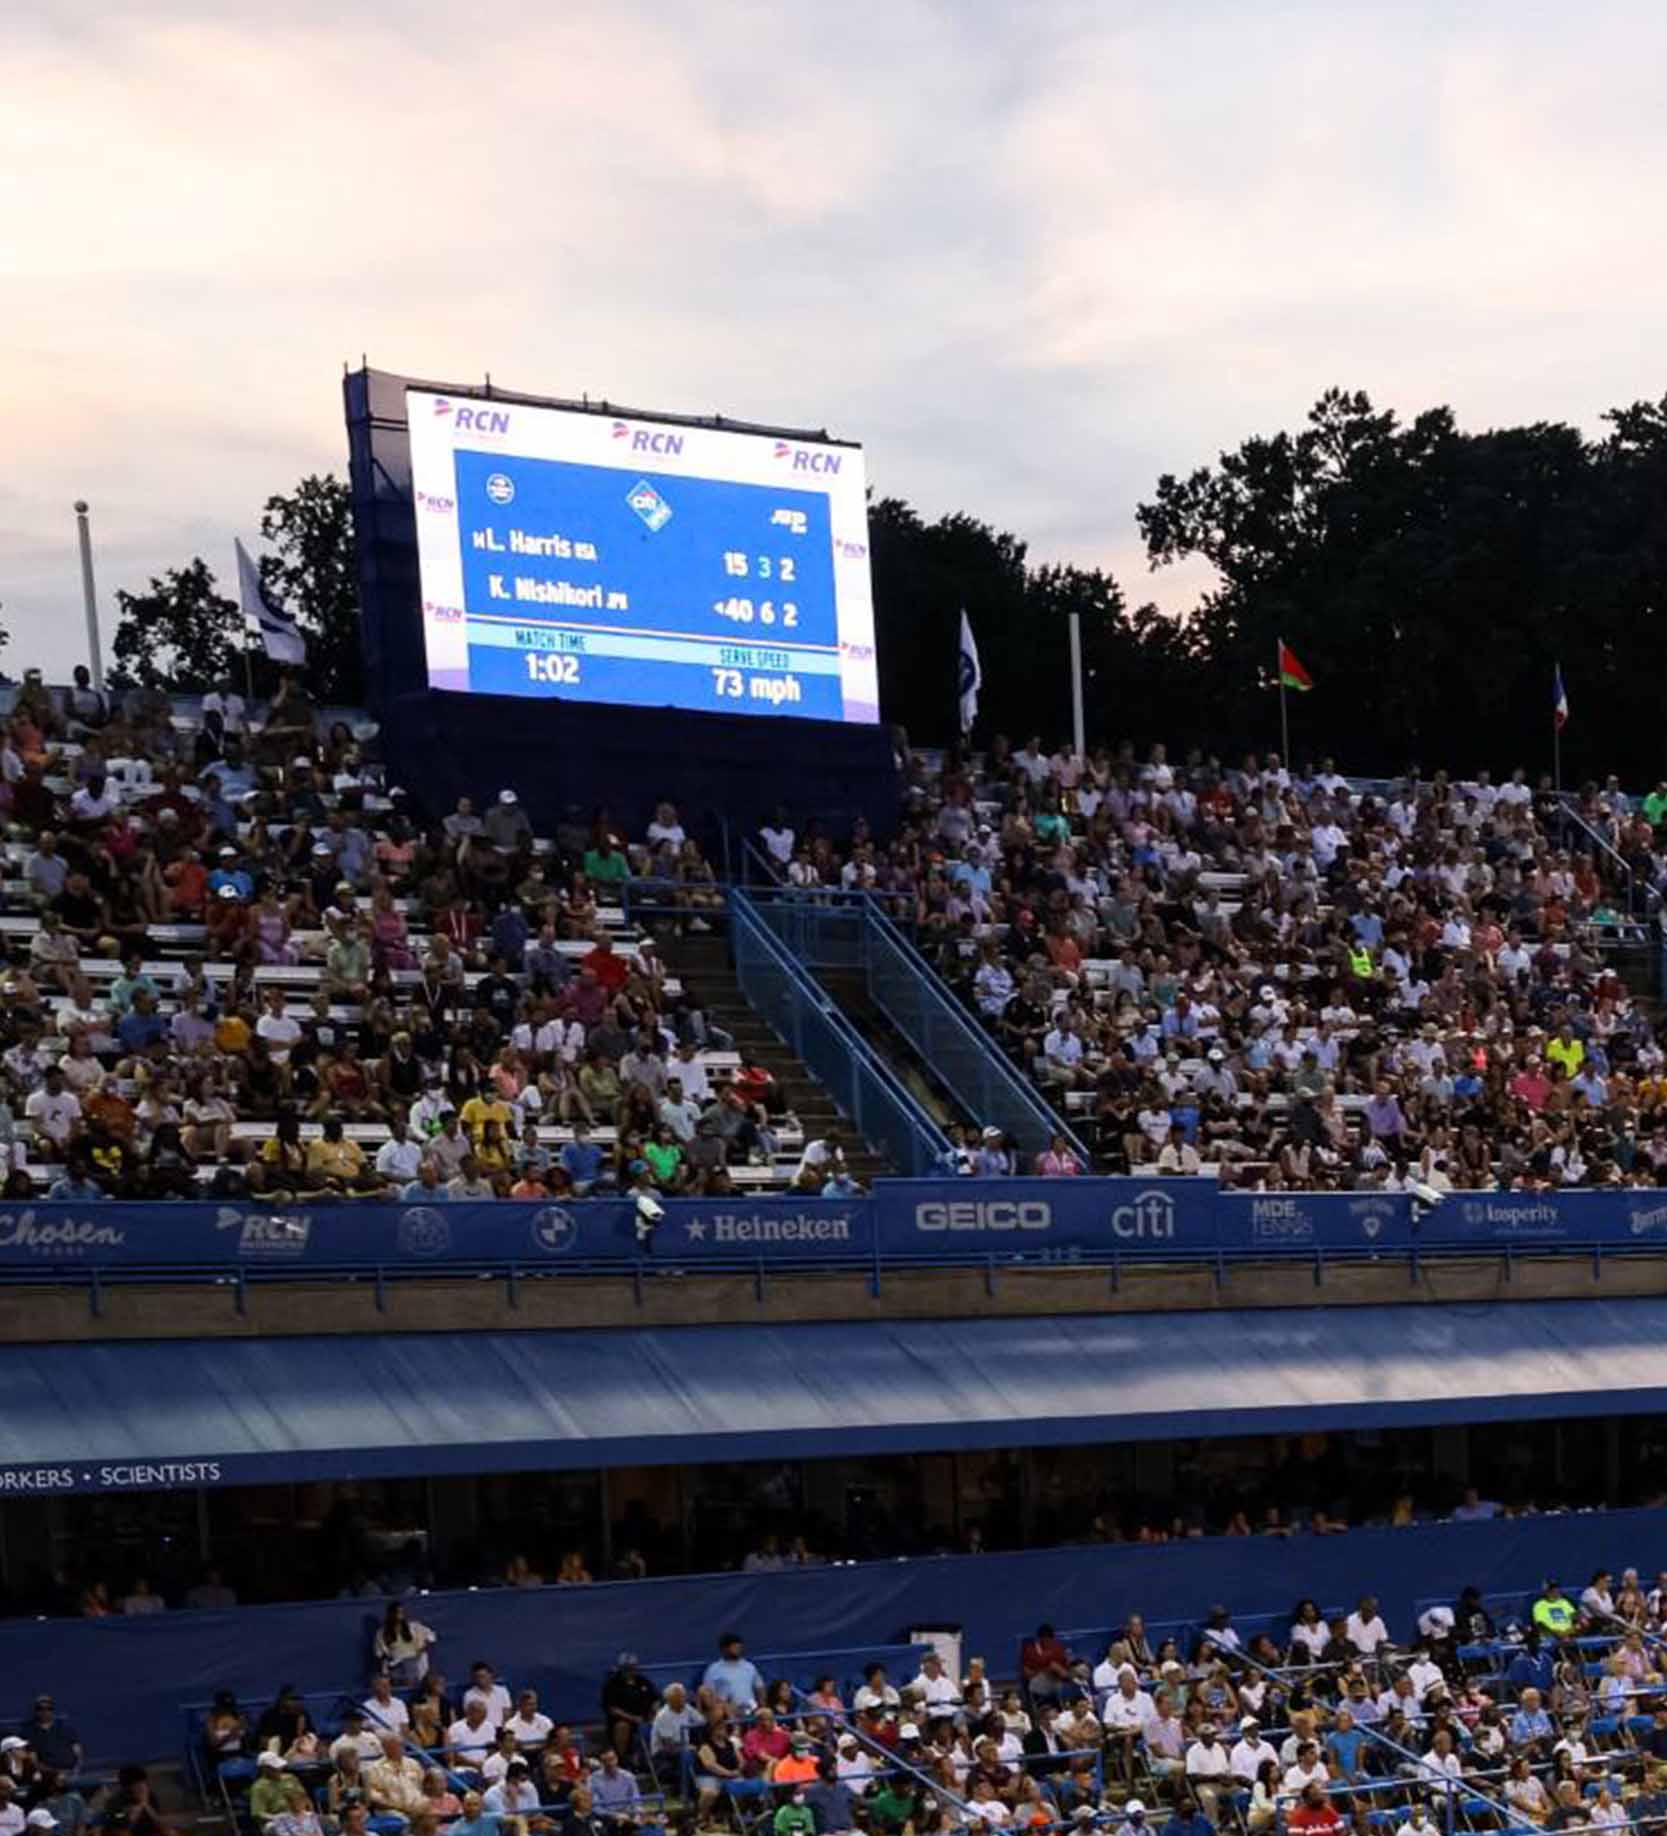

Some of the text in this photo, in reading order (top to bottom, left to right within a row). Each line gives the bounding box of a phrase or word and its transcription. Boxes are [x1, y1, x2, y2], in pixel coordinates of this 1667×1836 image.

[455, 408, 510, 433] RCN
[632, 430, 684, 454] RCN
[793, 450, 842, 474] RCN
[509, 529, 571, 559] Harris
[723, 551, 796, 581] 15 3 2
[488, 574, 510, 599] K.
[725, 597, 799, 627] 40 6 2
[514, 630, 586, 651] MATCH TIME
[525, 652, 581, 684] 1:02
[719, 647, 790, 668] SERVE SPEED
[712, 668, 801, 704] 73 mph
[916, 1202, 1051, 1232] GEICO
[1112, 1194, 1175, 1238] citi
[1487, 1202, 1559, 1226] Insperity
[714, 1214, 851, 1242] Heineken
[100, 1462, 221, 1485] SCIENTISTS
